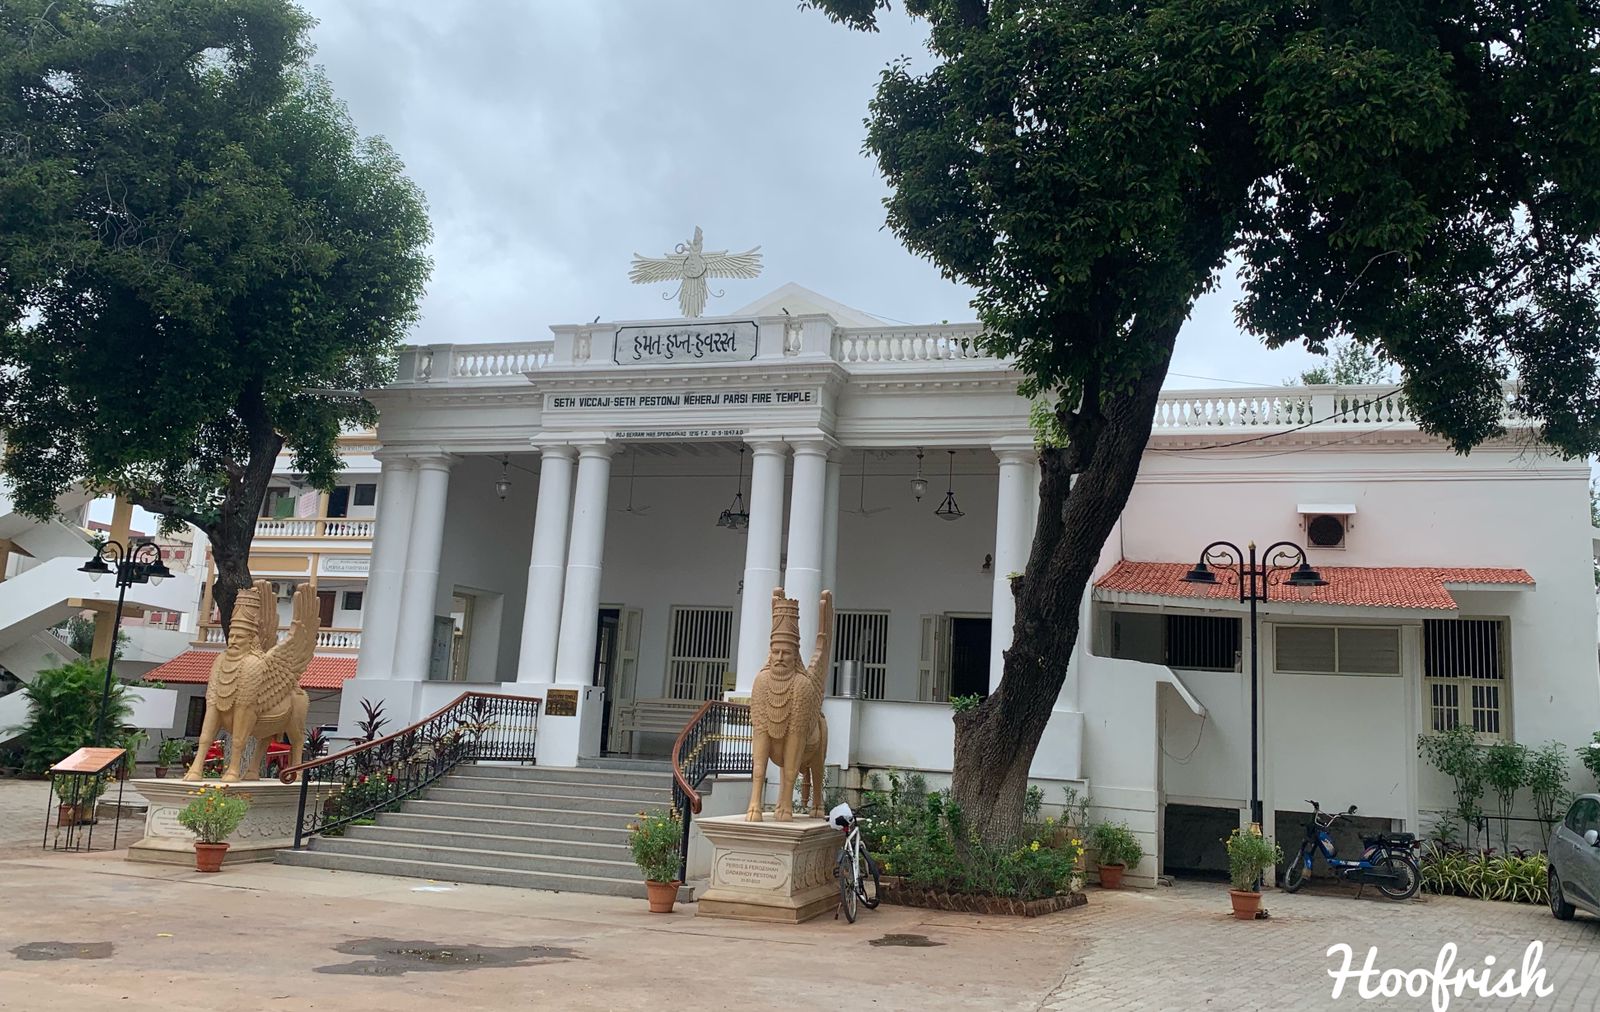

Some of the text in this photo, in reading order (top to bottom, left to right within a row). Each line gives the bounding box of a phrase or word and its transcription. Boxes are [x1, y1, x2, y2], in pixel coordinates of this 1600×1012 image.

[554, 398, 576, 408] SETH
[639, 395, 680, 406] PESTONJI
[684, 395, 720, 405] MEHERJI
[723, 394, 748, 404] PARSI
[752, 393, 772, 403] FIRE
[776, 392, 811, 402] TEMPLE
